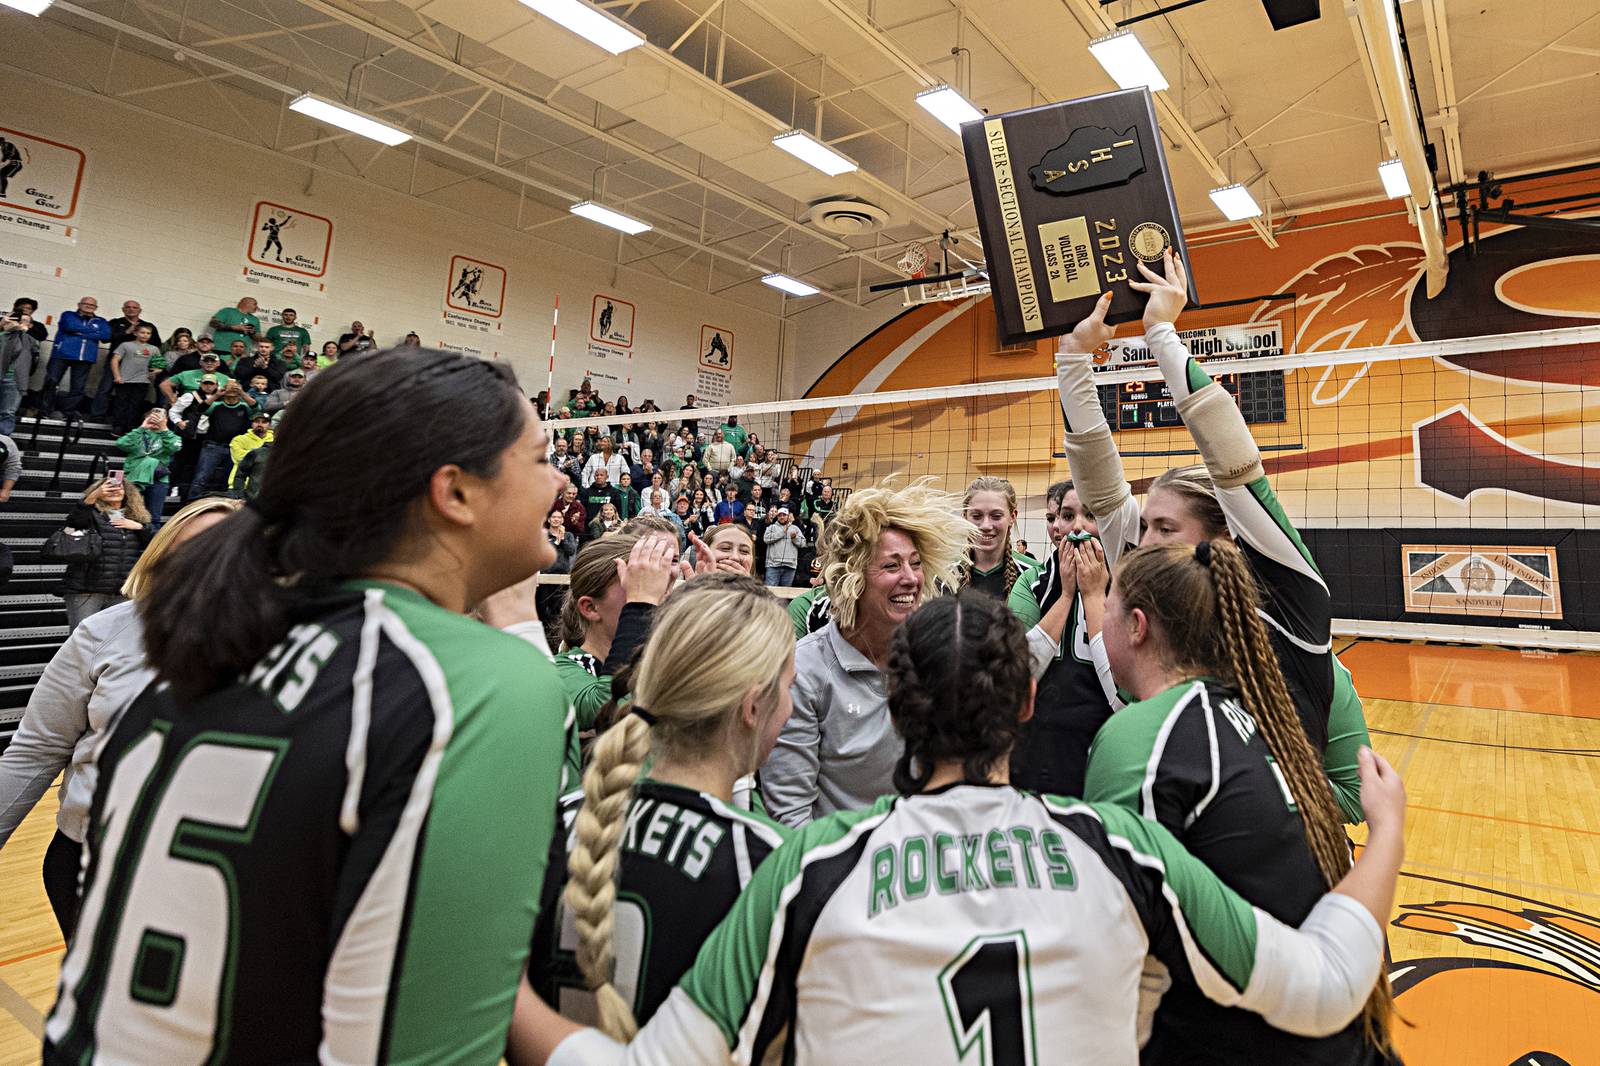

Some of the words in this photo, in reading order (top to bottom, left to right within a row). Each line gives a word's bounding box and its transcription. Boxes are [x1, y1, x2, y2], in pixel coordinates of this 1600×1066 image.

[16, 217, 50, 230] Champs
[1045, 244, 1059, 267] CLASS
[1058, 235, 1079, 283] VOLLEYBALL
[1075, 244, 1090, 268] GIRLS
[1094, 217, 1128, 283] 2023
[0, 258, 27, 268] hamps
[1050, 269, 1061, 280] 2A
[249, 269, 284, 281] Conference
[286, 277, 310, 287] Champs
[1012, 248, 1038, 322] CHAMPIONS
[1190, 336, 1223, 356] High
[1225, 331, 1277, 353] School
[1208, 328, 1217, 336] TO
[1122, 403, 1139, 411] FOULS
[1421, 560, 1450, 580] INDIANS
[1493, 554, 1515, 571] LADY
[1516, 568, 1552, 590] INDIANS
[1456, 598, 1502, 607] SANDWICH
[563, 796, 726, 882] KETS
[867, 824, 1078, 919] ROCKETS
[45, 720, 290, 1066] 16
[938, 928, 1038, 1066] 1
